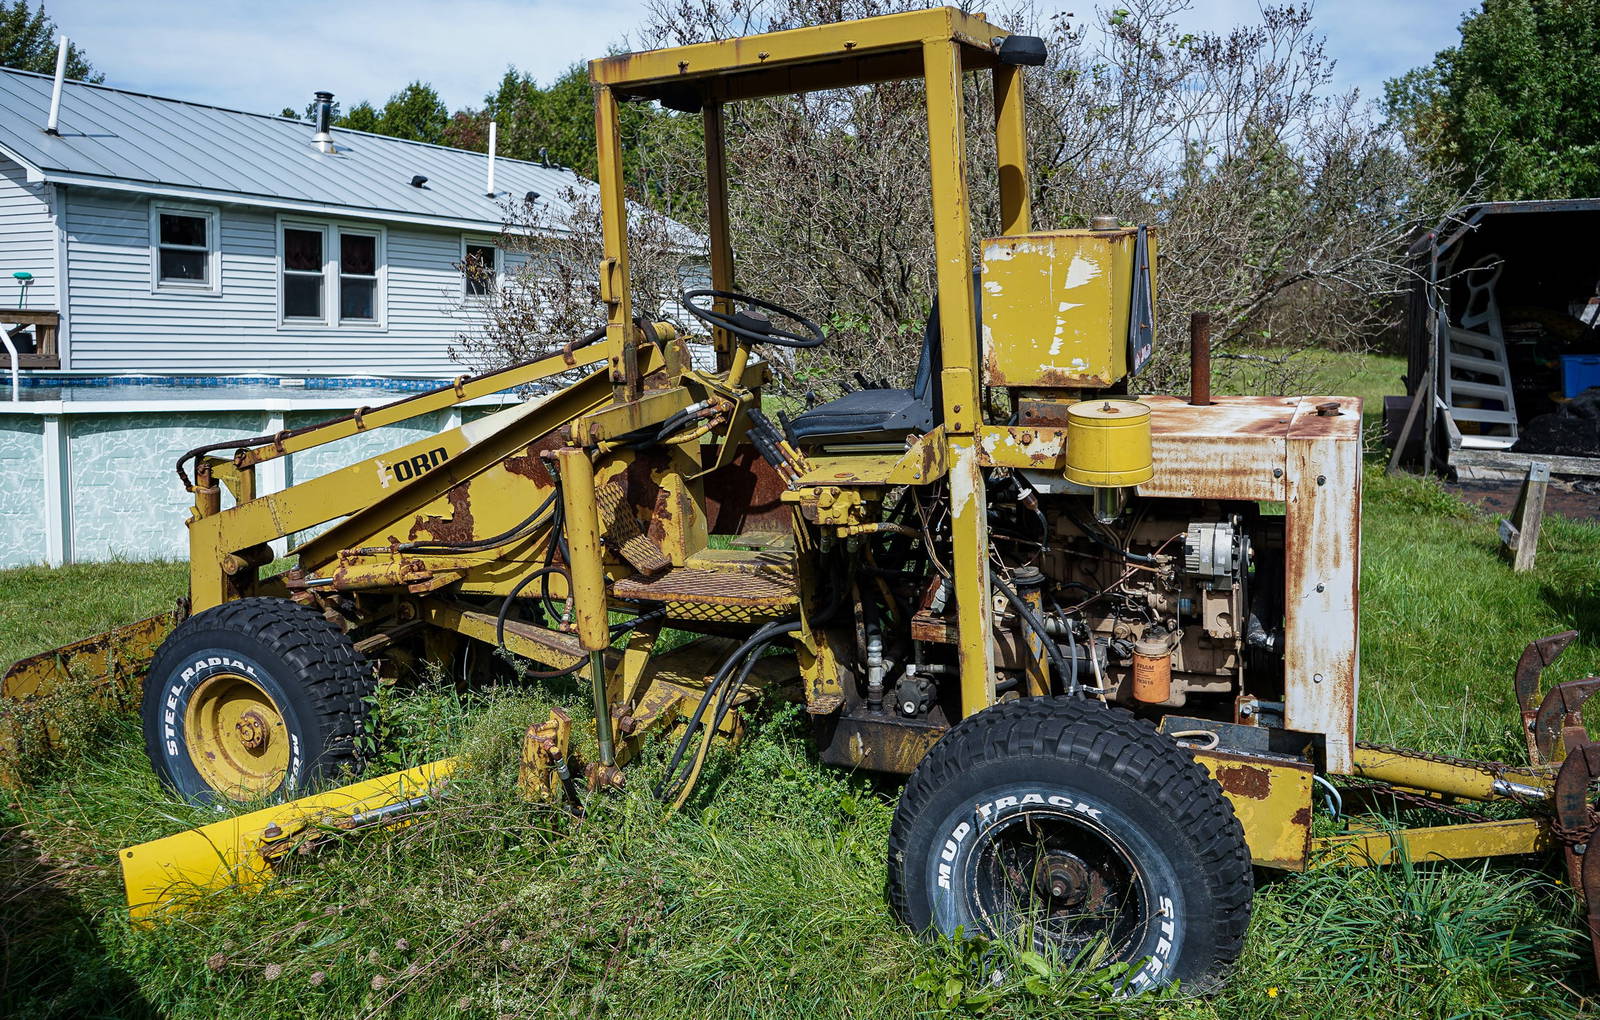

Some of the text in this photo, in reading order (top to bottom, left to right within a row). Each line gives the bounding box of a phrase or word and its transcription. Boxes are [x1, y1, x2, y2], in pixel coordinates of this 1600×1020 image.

[164, 657, 258, 756] STEEL RADIAL
[937, 793, 1103, 890] MUD TRACK
